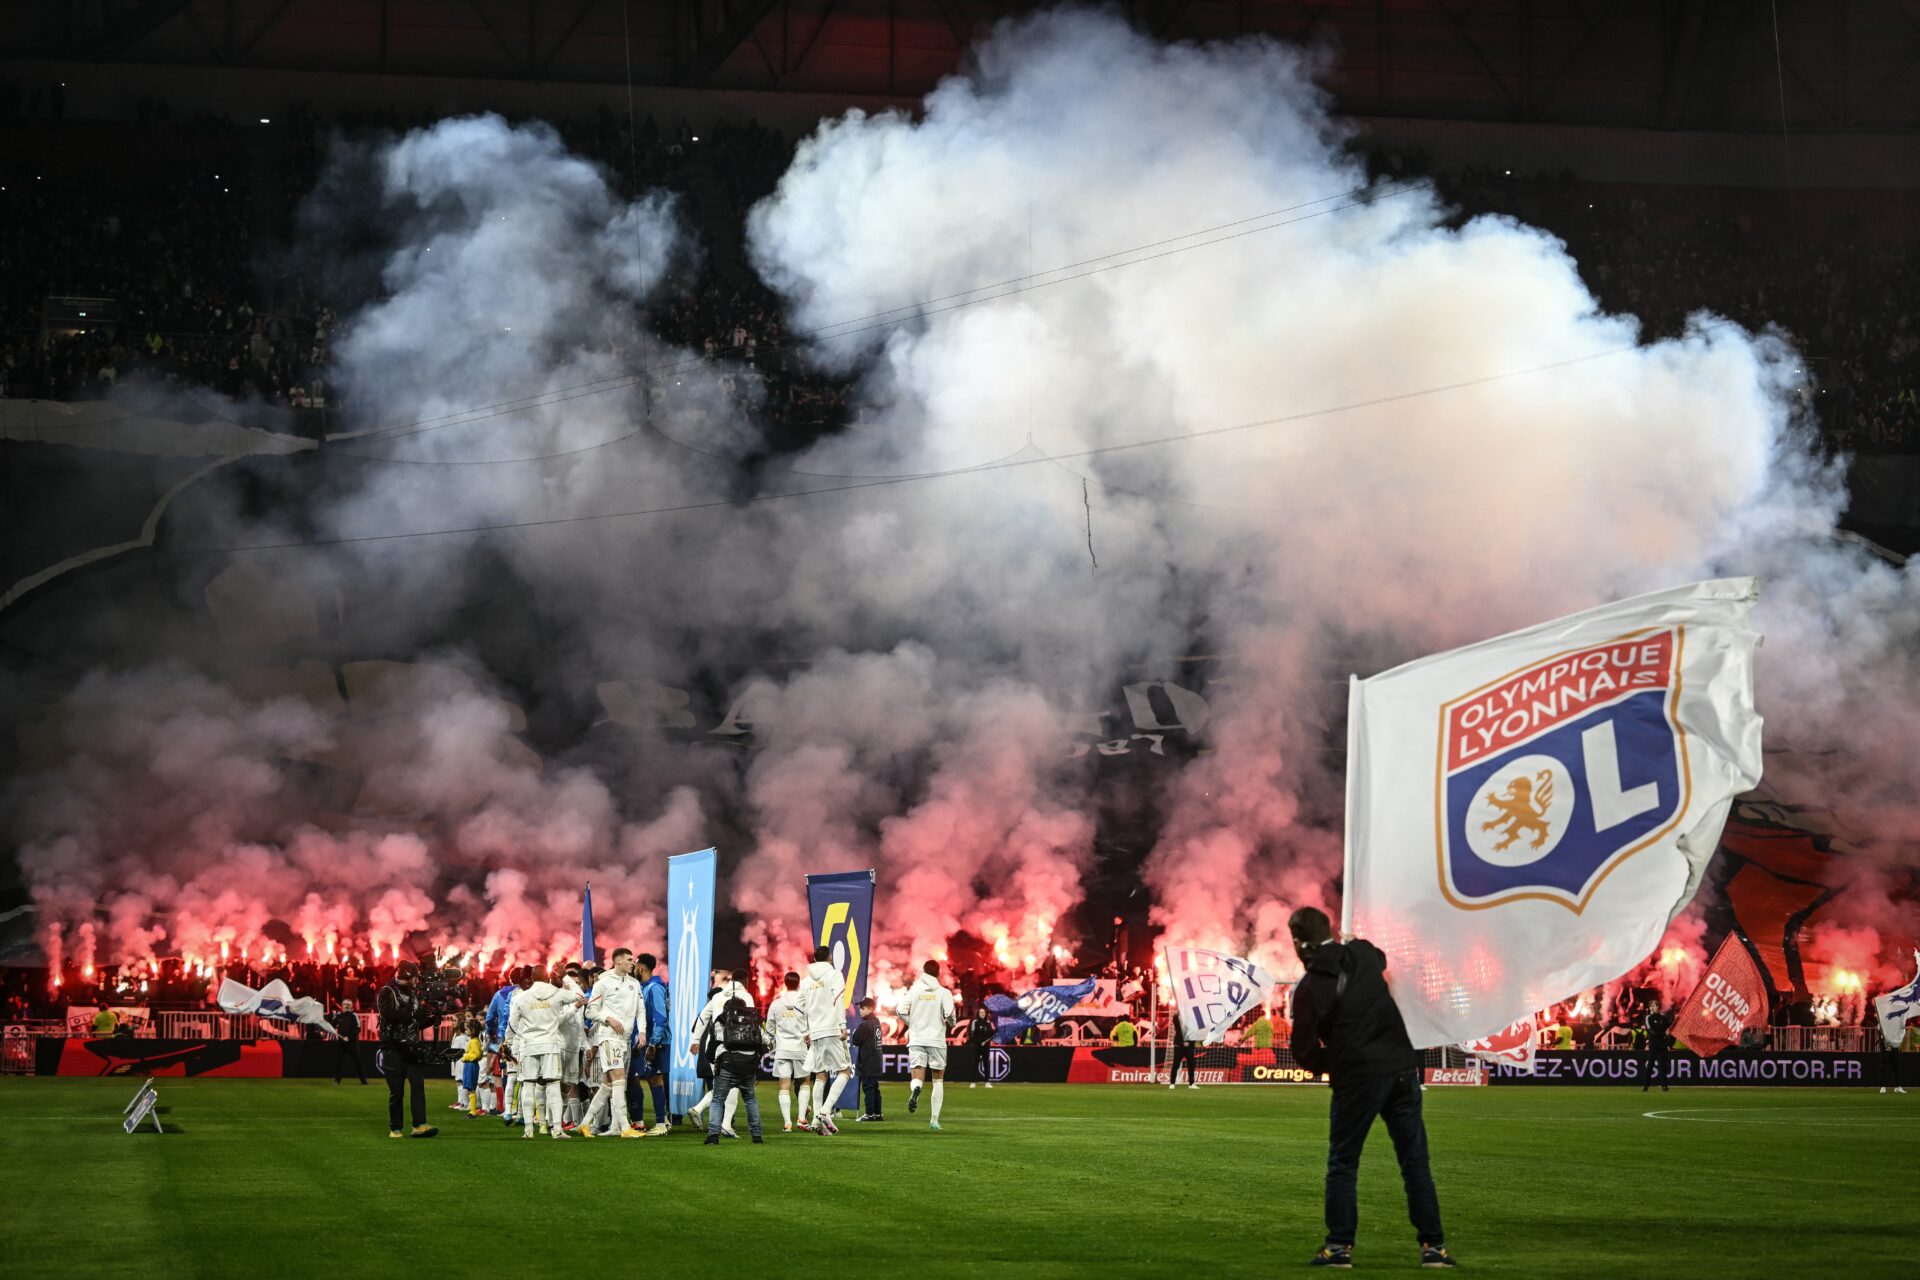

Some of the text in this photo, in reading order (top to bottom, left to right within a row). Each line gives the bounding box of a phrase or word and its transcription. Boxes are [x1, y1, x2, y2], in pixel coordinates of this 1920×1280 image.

[1460, 644, 1662, 729] OLYMPIQUE
[1459, 671, 1658, 759] LYONNAIS
[1705, 973, 1750, 1016] OLYMP
[612, 1048, 622, 1058] 12
[1699, 1059, 1862, 1078] MGMOTOR.FR
[1253, 1066, 1313, 1082] Orange
